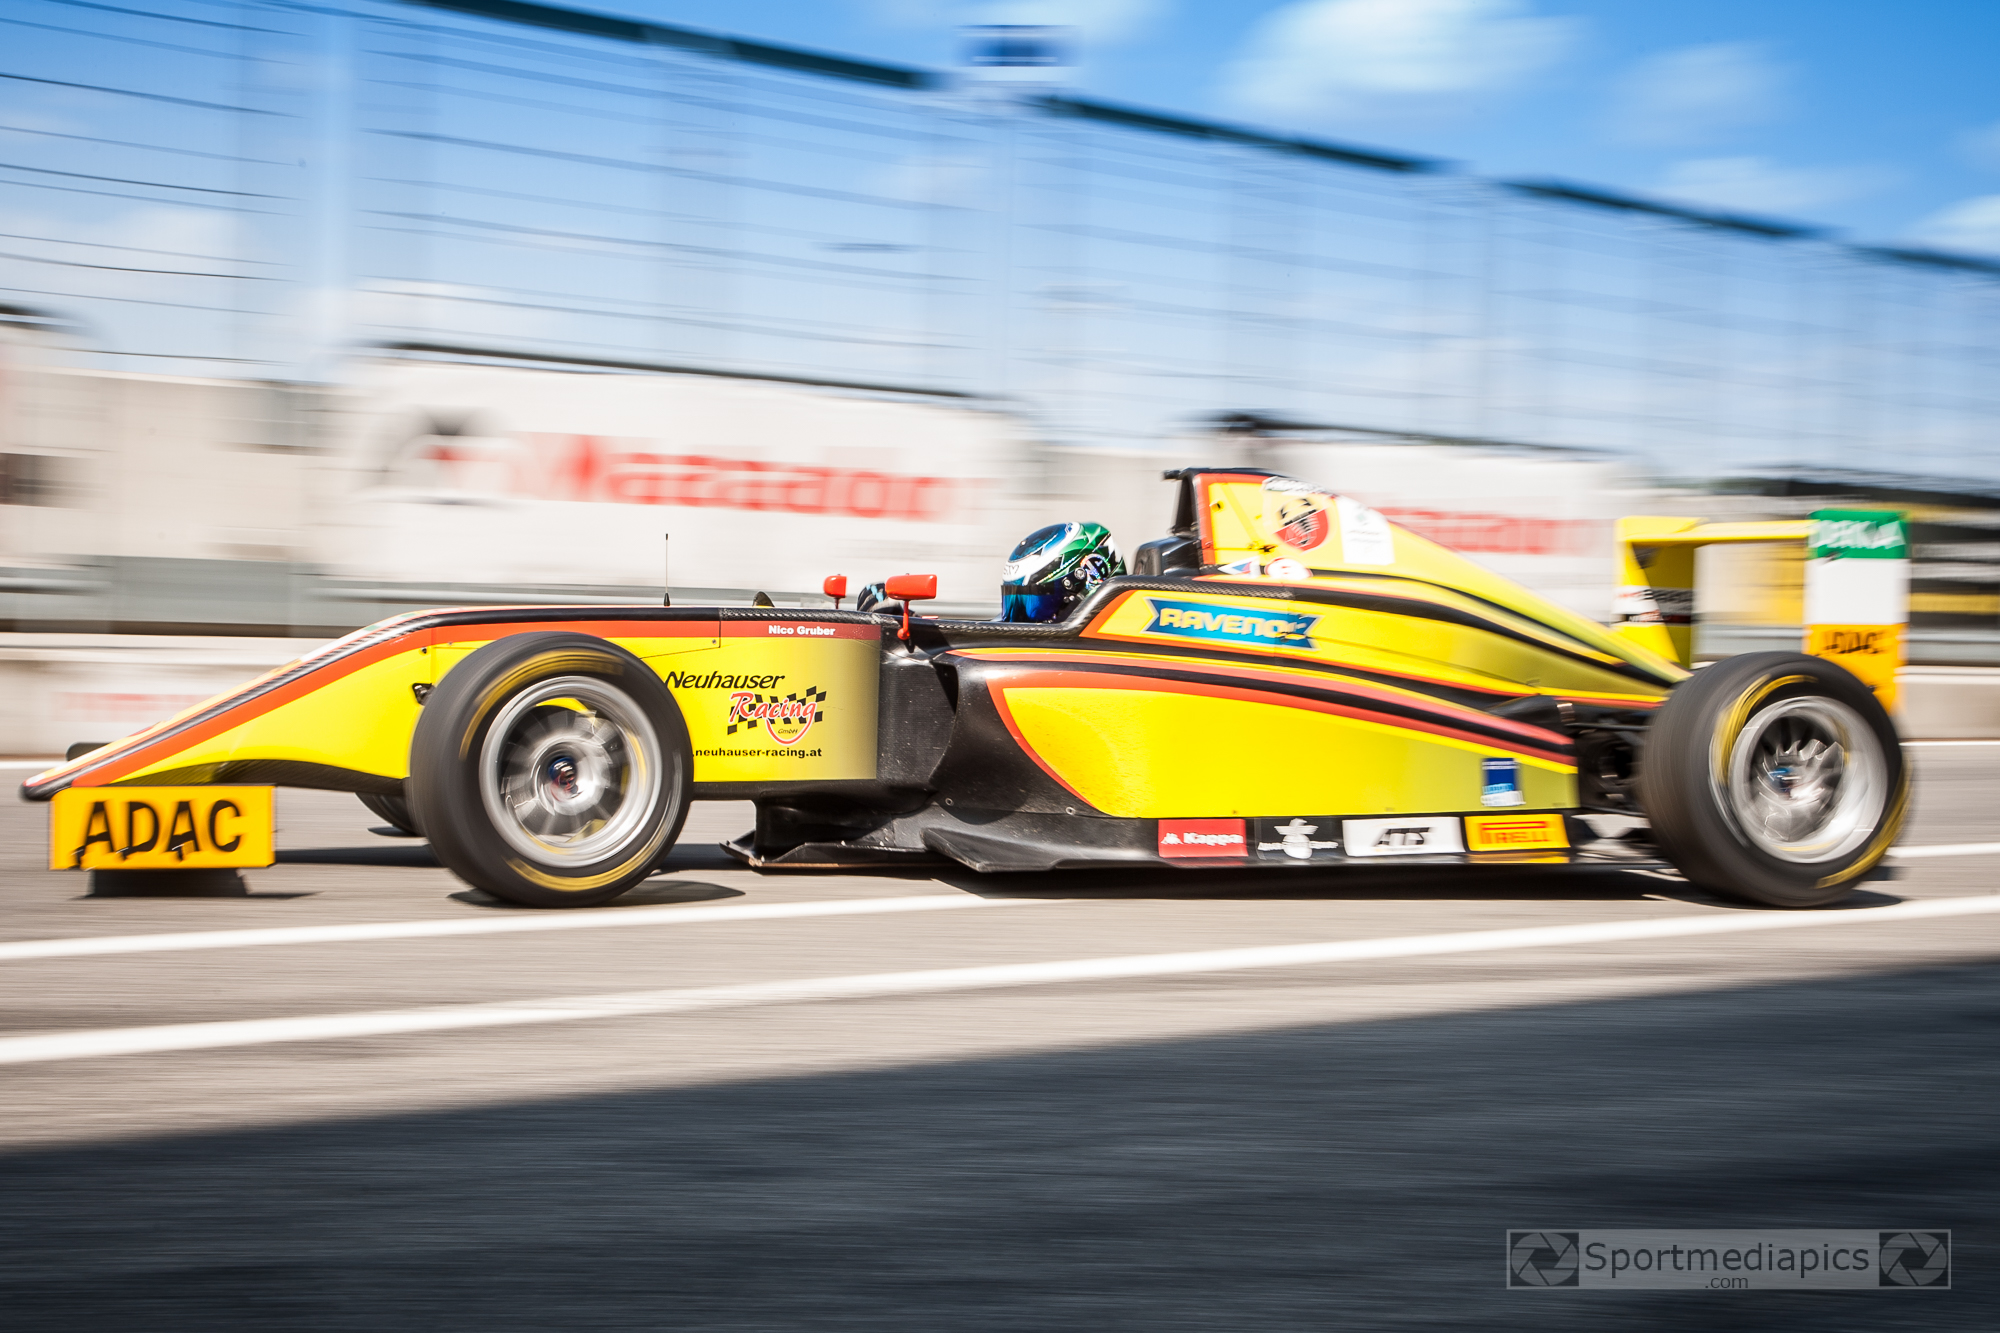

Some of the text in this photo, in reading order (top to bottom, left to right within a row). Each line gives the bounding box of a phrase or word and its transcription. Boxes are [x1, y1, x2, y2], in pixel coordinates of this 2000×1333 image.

[768, 625, 835, 636] Nico Gruber
[665, 671, 785, 689] Neuhauser
[728, 691, 818, 746] Racing
[80, 799, 242, 862] ADAC
[1183, 833, 1244, 846] Kappa
